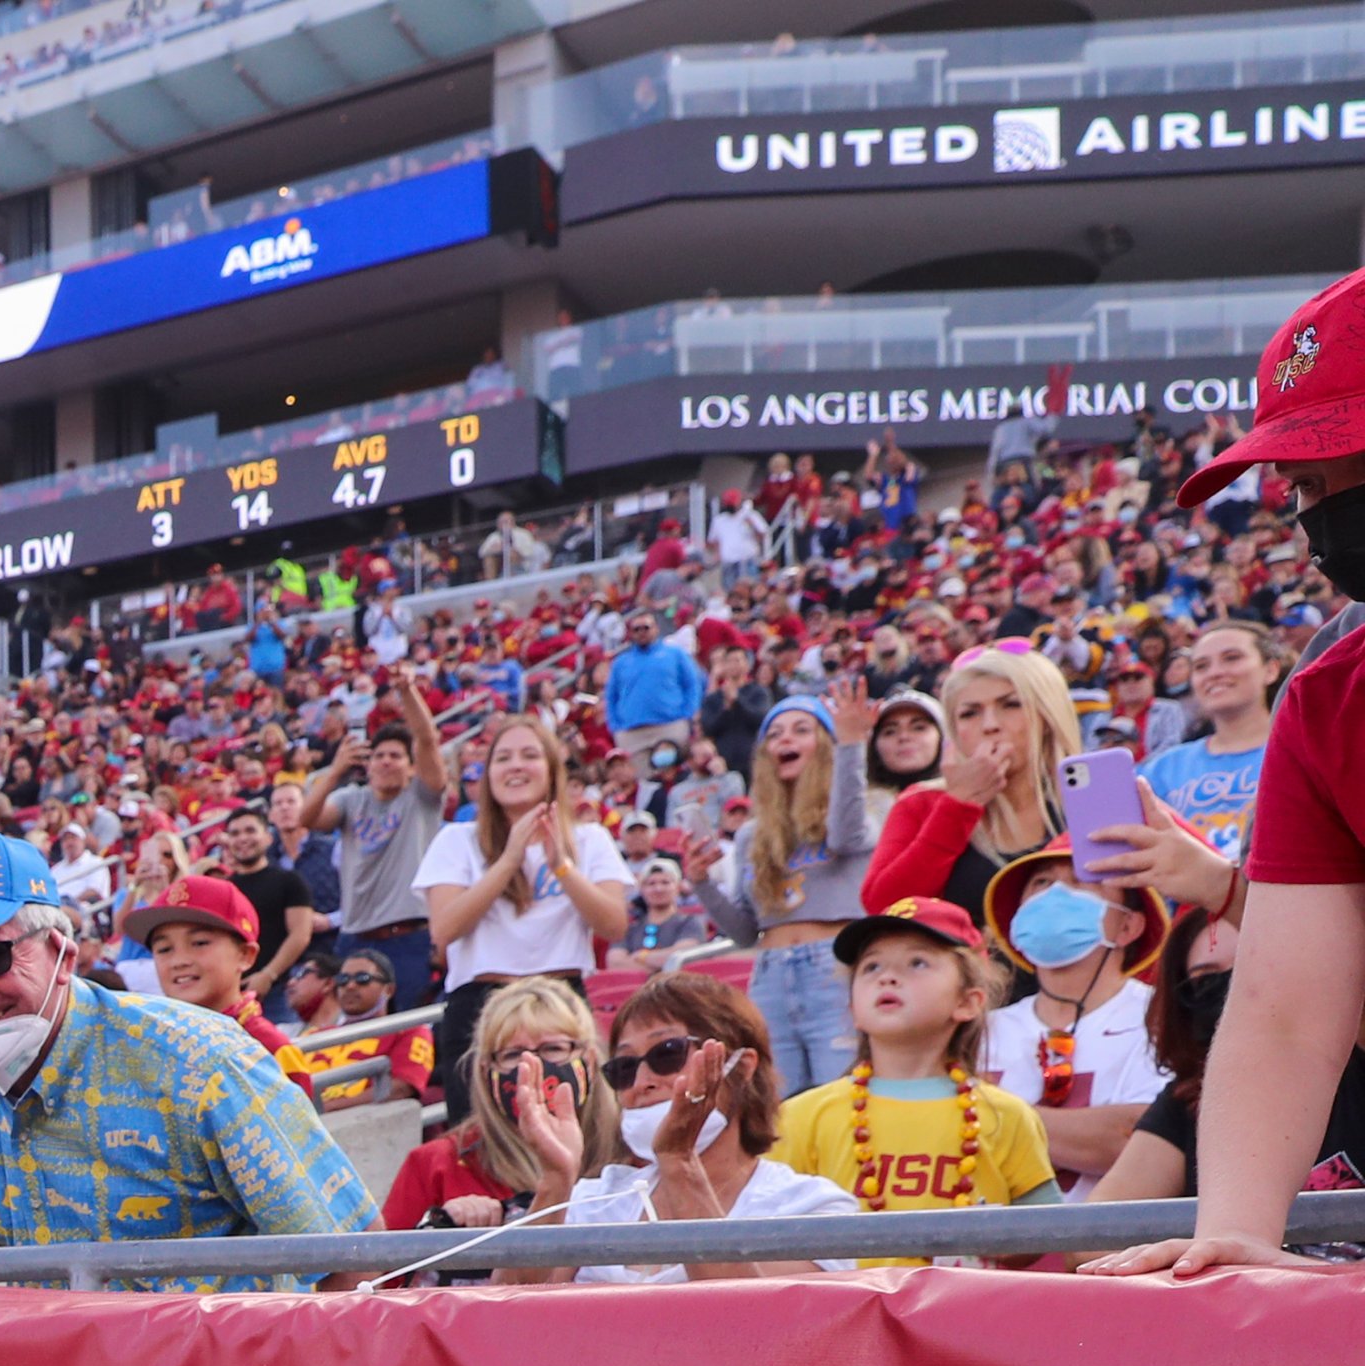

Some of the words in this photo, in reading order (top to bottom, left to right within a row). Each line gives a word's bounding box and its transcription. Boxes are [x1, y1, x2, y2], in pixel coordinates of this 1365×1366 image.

[715, 124, 980, 174] UNITED
[220, 227, 313, 278] ABM
[680, 394, 751, 430] LOS
[758, 388, 929, 430] ANGELES
[136, 478, 185, 512] ATT
[226, 458, 279, 493] YDS
[332, 434, 388, 471] AVG
[440, 415, 480, 446] TD
[151, 511, 174, 547] 3
[231, 490, 273, 531] 14
[331, 465, 387, 509] 4.7
[450, 447, 476, 487] 0
[104, 1128, 166, 1154] UCLA
[853, 1154, 970, 1201] USC
